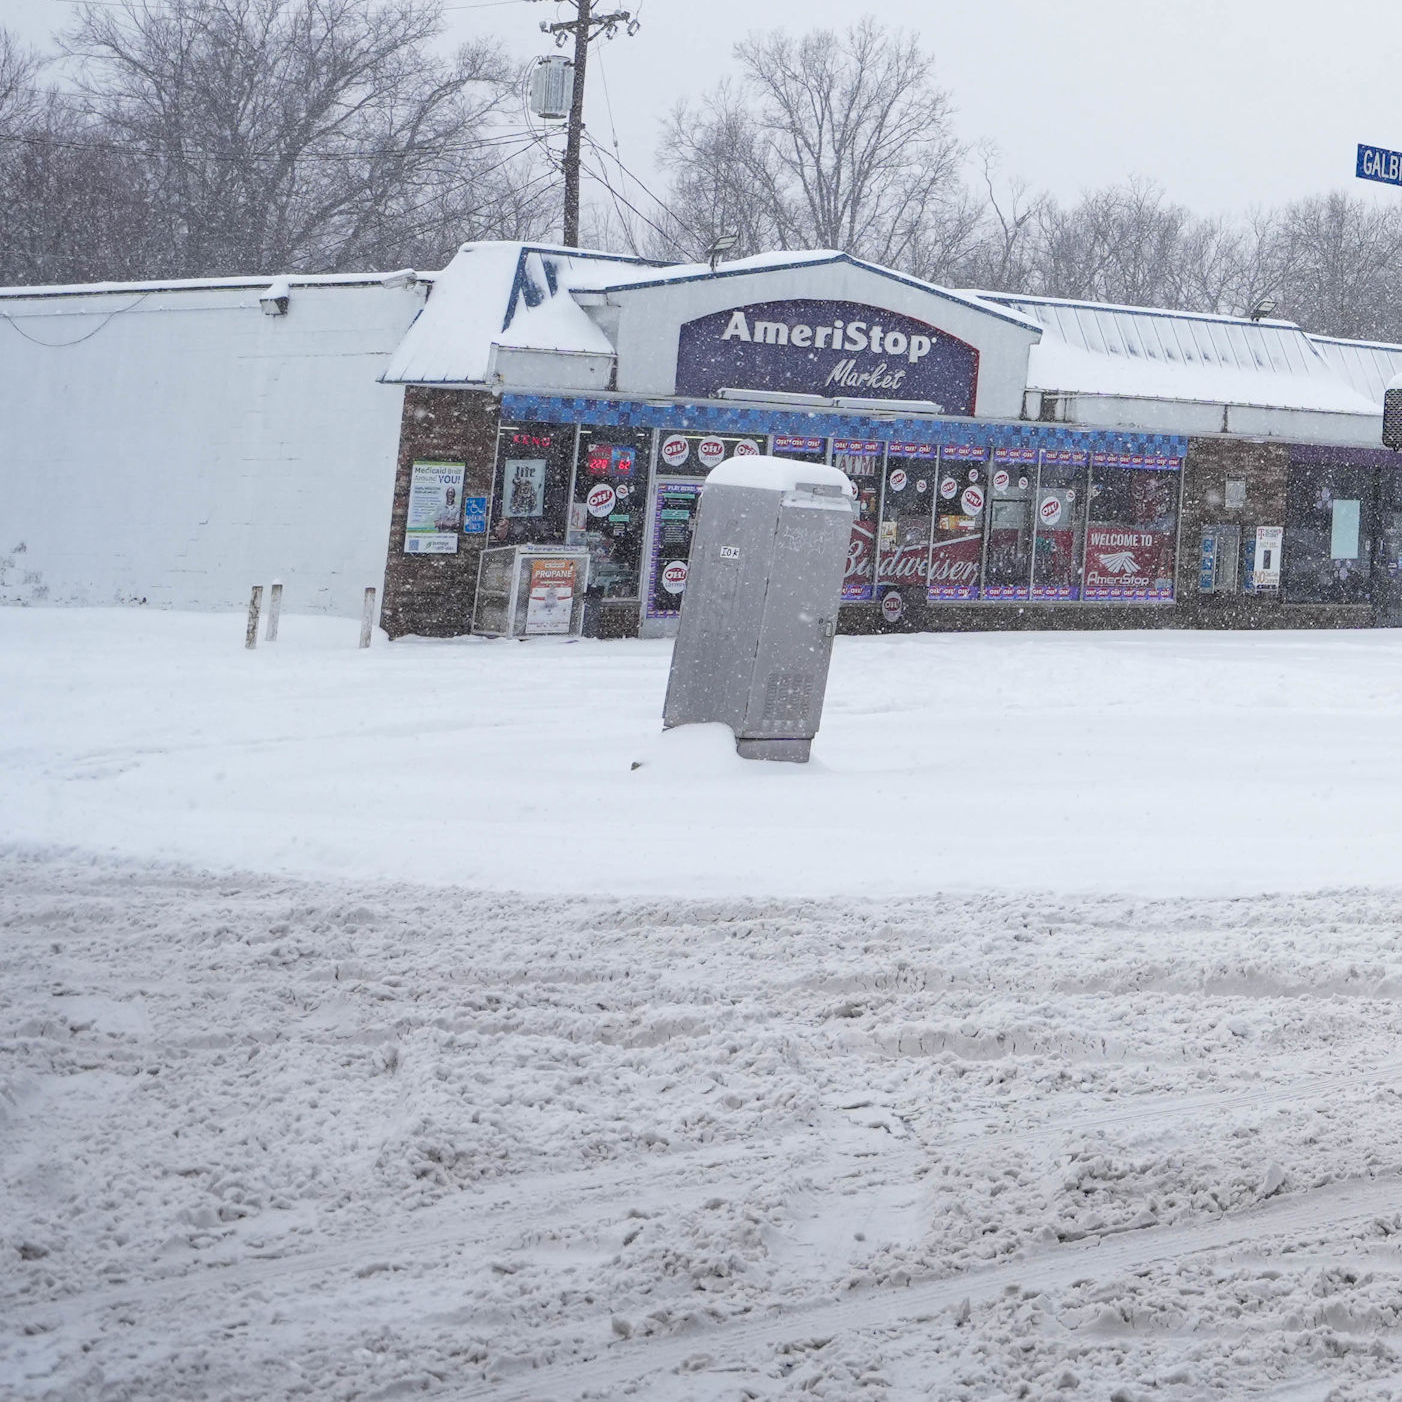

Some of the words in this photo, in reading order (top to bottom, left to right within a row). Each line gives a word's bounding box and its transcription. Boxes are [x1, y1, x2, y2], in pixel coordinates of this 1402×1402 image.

[721, 311, 932, 363] AmeriStop
[824, 358, 907, 390] Market
[664, 442, 687, 455] OH!
[701, 443, 723, 454] OH!
[415, 466, 447, 474] Medicaid
[439, 475, 461, 485] YOU!
[589, 490, 612, 506] OH!
[1091, 534, 1139, 547] WELCOME
[1141, 534, 1153, 547] TO
[535, 569, 573, 578] PROPANE
[665, 569, 687, 580] OH!
[1087, 571, 1150, 586] AmeriStop
